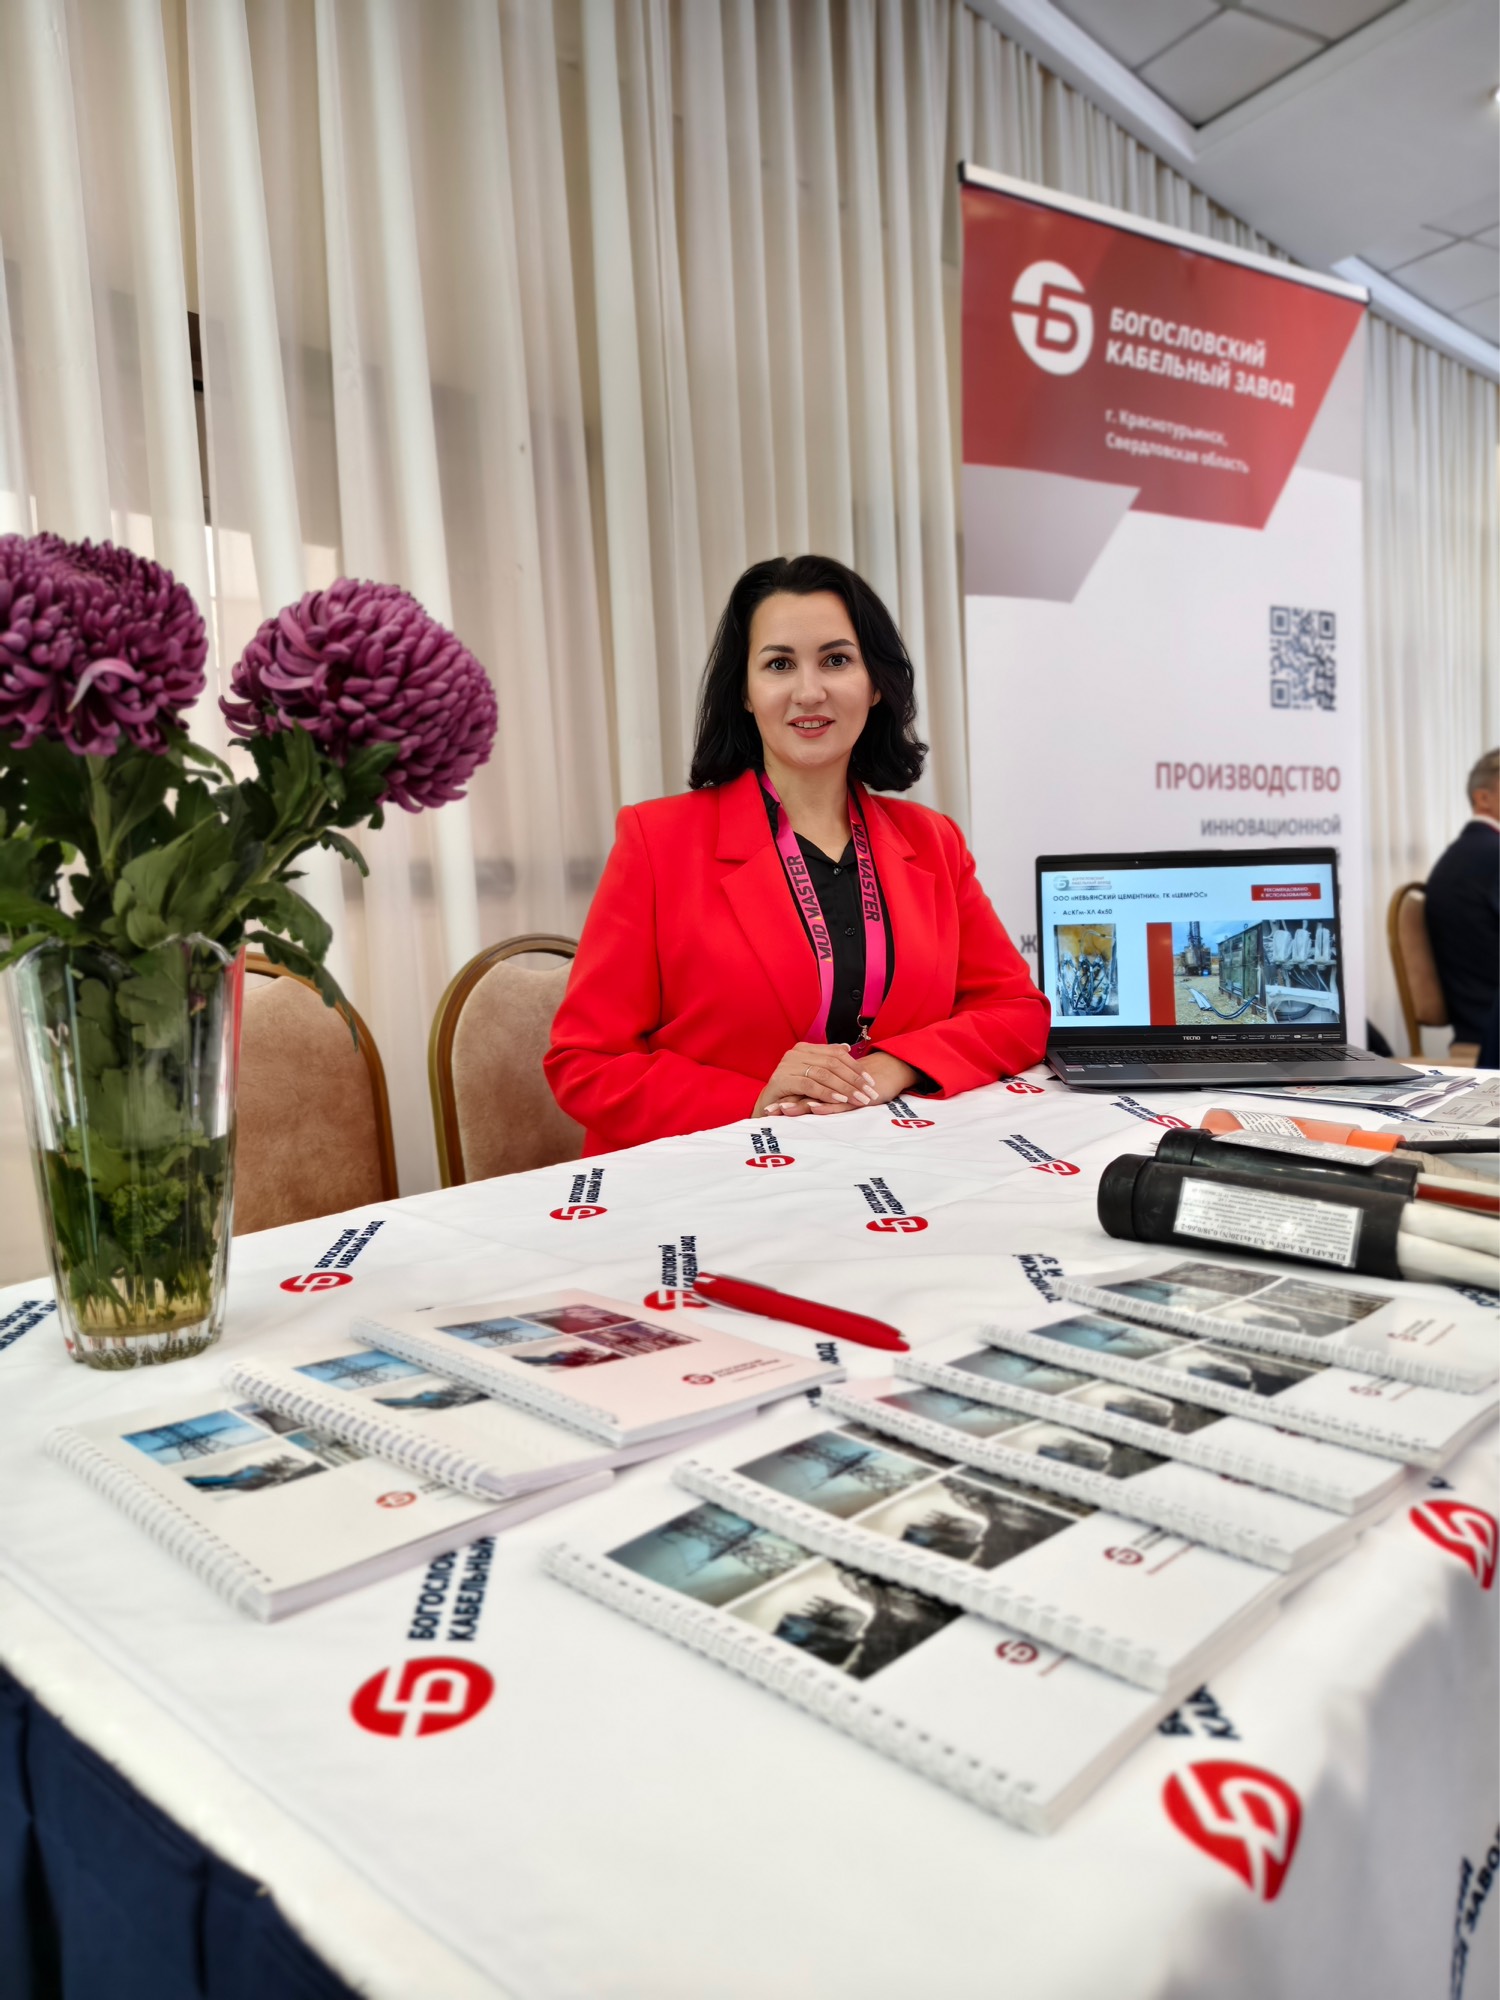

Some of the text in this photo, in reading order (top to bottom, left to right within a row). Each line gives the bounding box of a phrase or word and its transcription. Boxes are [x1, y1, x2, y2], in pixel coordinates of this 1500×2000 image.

[1109, 307, 1267, 369] БОГОСЛОВСКИЙ
[1105, 339, 1296, 409] КАБЕЛЬНЫЙ ЗАВОД
[1104, 408, 1117, 424] г.
[1105, 431, 1250, 475] Свердловская область
[1155, 762, 1342, 798] ПРОИЗВОДСТВО
[1200, 813, 1342, 839] ИННОВАЦИОННОЙ
[850, 818, 881, 923] MUD MASTER
[786, 854, 833, 962] MUD MASTER
[1053, 894, 1070, 902] ООО
[1071, 893, 1116, 902] «НЕВЬЯНСКИЙ
[1172, 891, 1208, 899] «ЦЕМРОС»
[314, 1229, 360, 1268] БОГОСЛОВСКИЙ
[334, 1220, 386, 1268] КАБЕЛЬНЫЙ ЗАВОД
[1298, 1246, 1347, 1261] ELKAFLEX
[1465, 1823, 1500, 1934] ЗАВО
